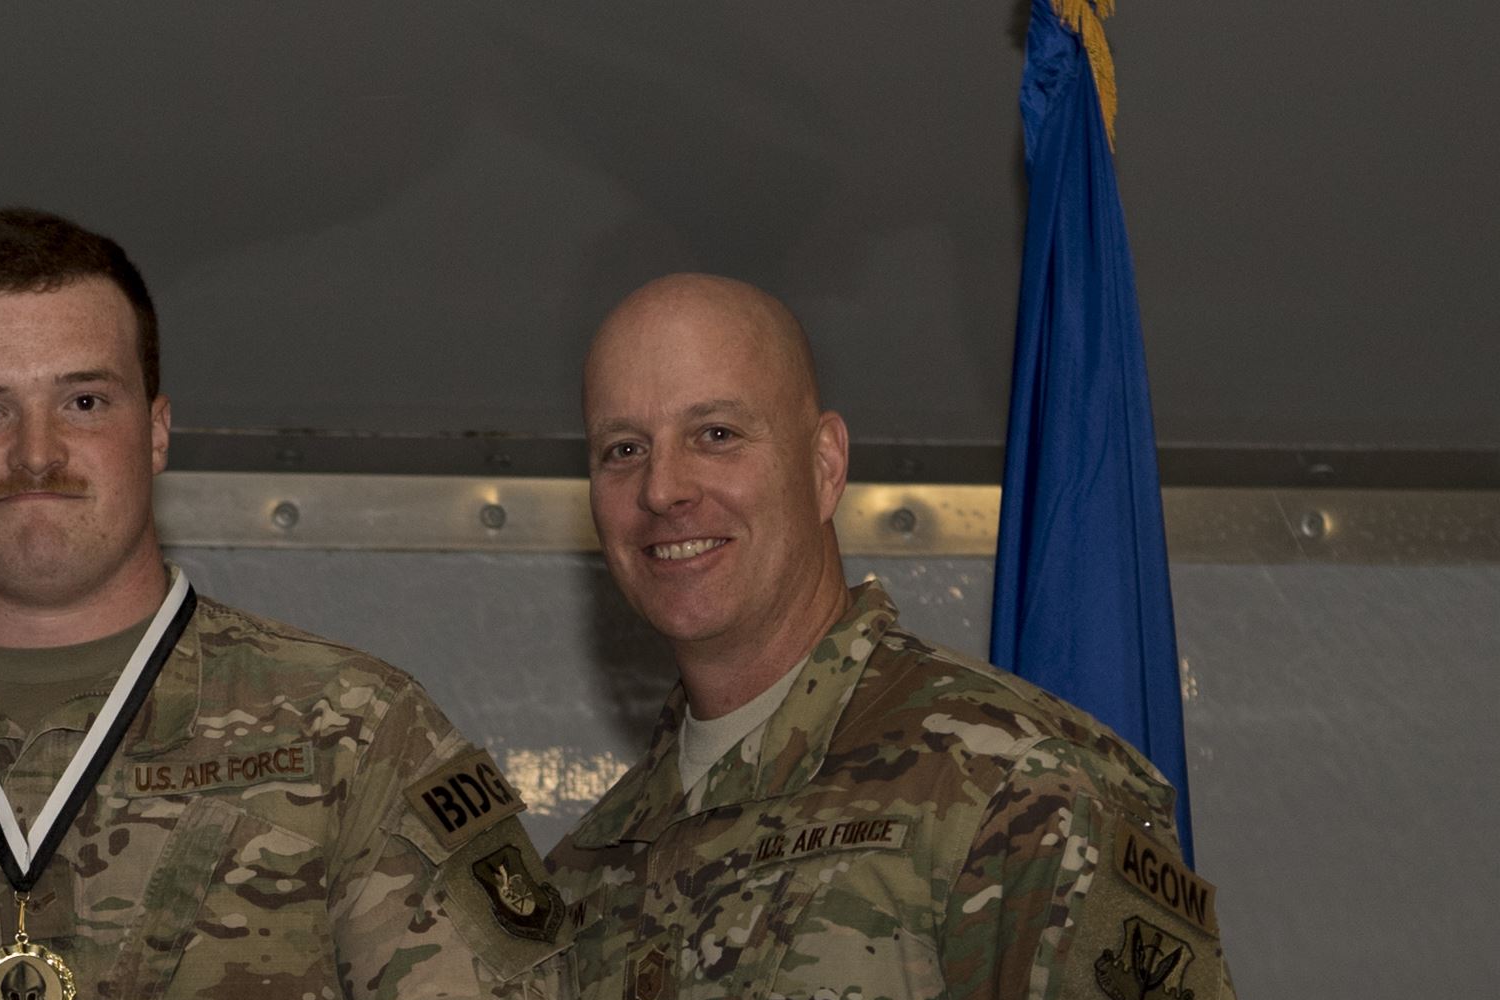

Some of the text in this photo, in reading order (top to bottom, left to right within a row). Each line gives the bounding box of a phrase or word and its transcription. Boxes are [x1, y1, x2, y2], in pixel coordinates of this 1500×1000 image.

[135, 747, 304, 791] U.S. AIR FORCE
[421, 762, 514, 834] BDG
[791, 826, 828, 854] AIR
[830, 819, 898, 846] FORCE
[1123, 834, 1207, 926] AGOW
